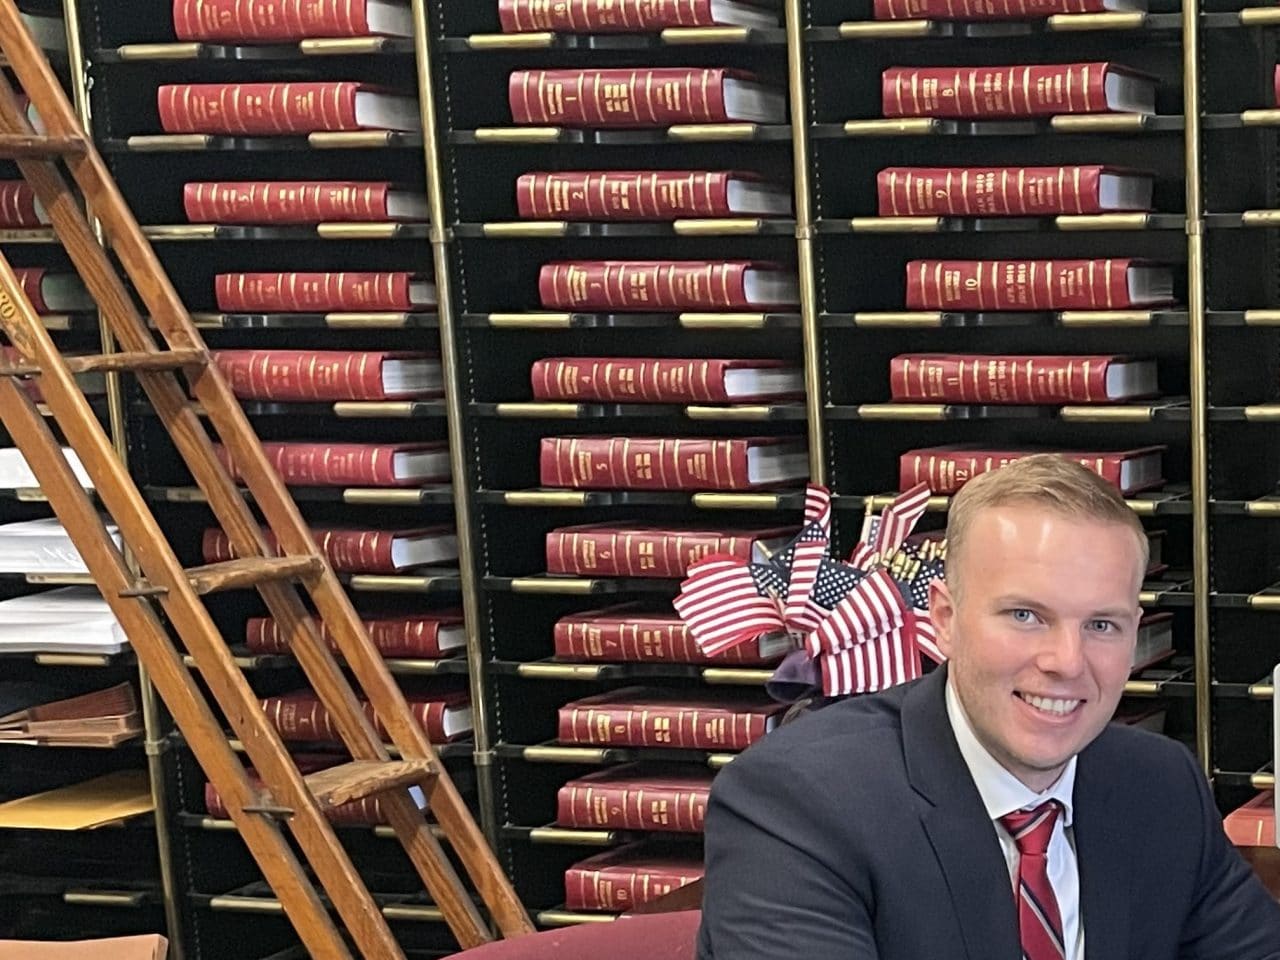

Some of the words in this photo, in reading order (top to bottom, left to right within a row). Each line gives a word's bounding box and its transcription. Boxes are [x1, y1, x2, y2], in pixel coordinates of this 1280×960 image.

[572, 191, 584, 200] 2
[965, 278, 977, 290] 10
[956, 469, 969, 482] 12
